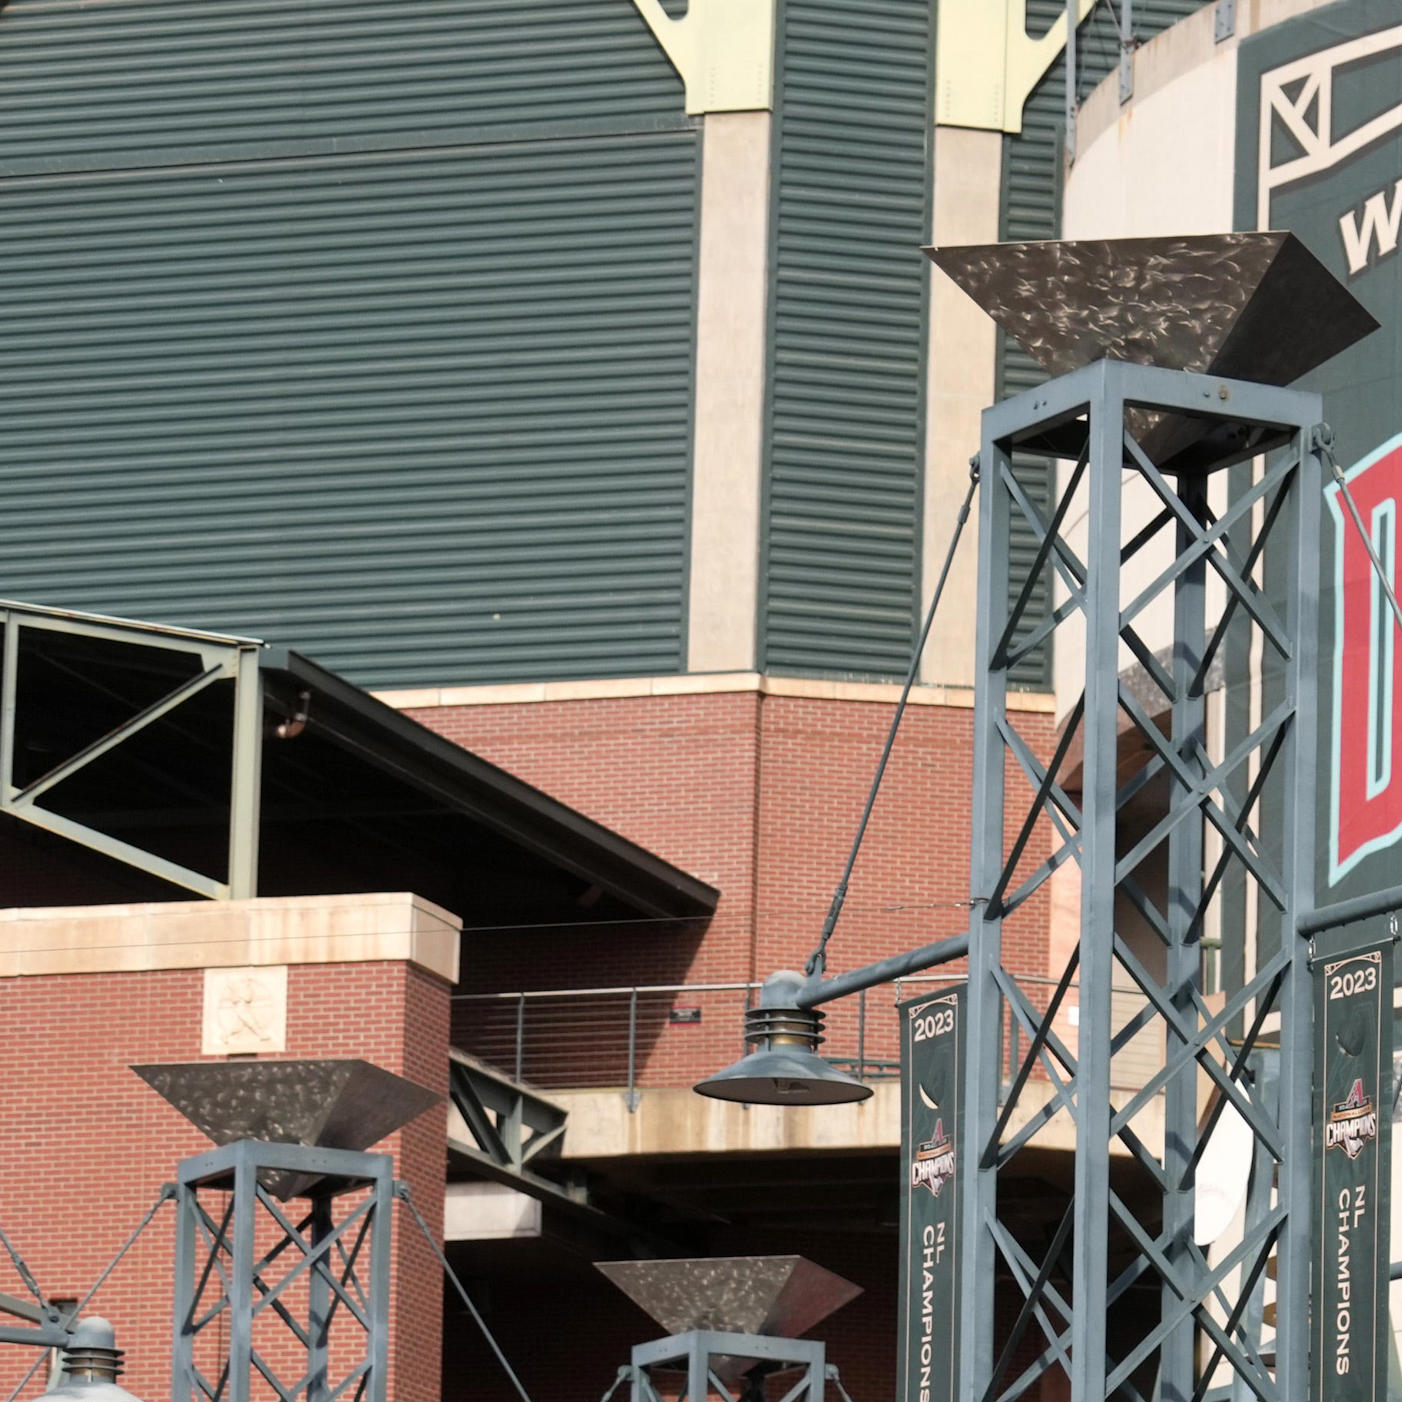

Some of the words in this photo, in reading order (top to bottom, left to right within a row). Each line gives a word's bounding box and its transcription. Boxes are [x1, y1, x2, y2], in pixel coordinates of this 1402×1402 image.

[1330, 967, 1376, 1000] 2023
[913, 1010, 954, 1042] 2023
[1326, 1112, 1376, 1147] CHAMPIONS
[1354, 1185, 1366, 1228] NL
[936, 1222, 945, 1264] NL
[1336, 1188, 1351, 1376] CHAMPIONS
